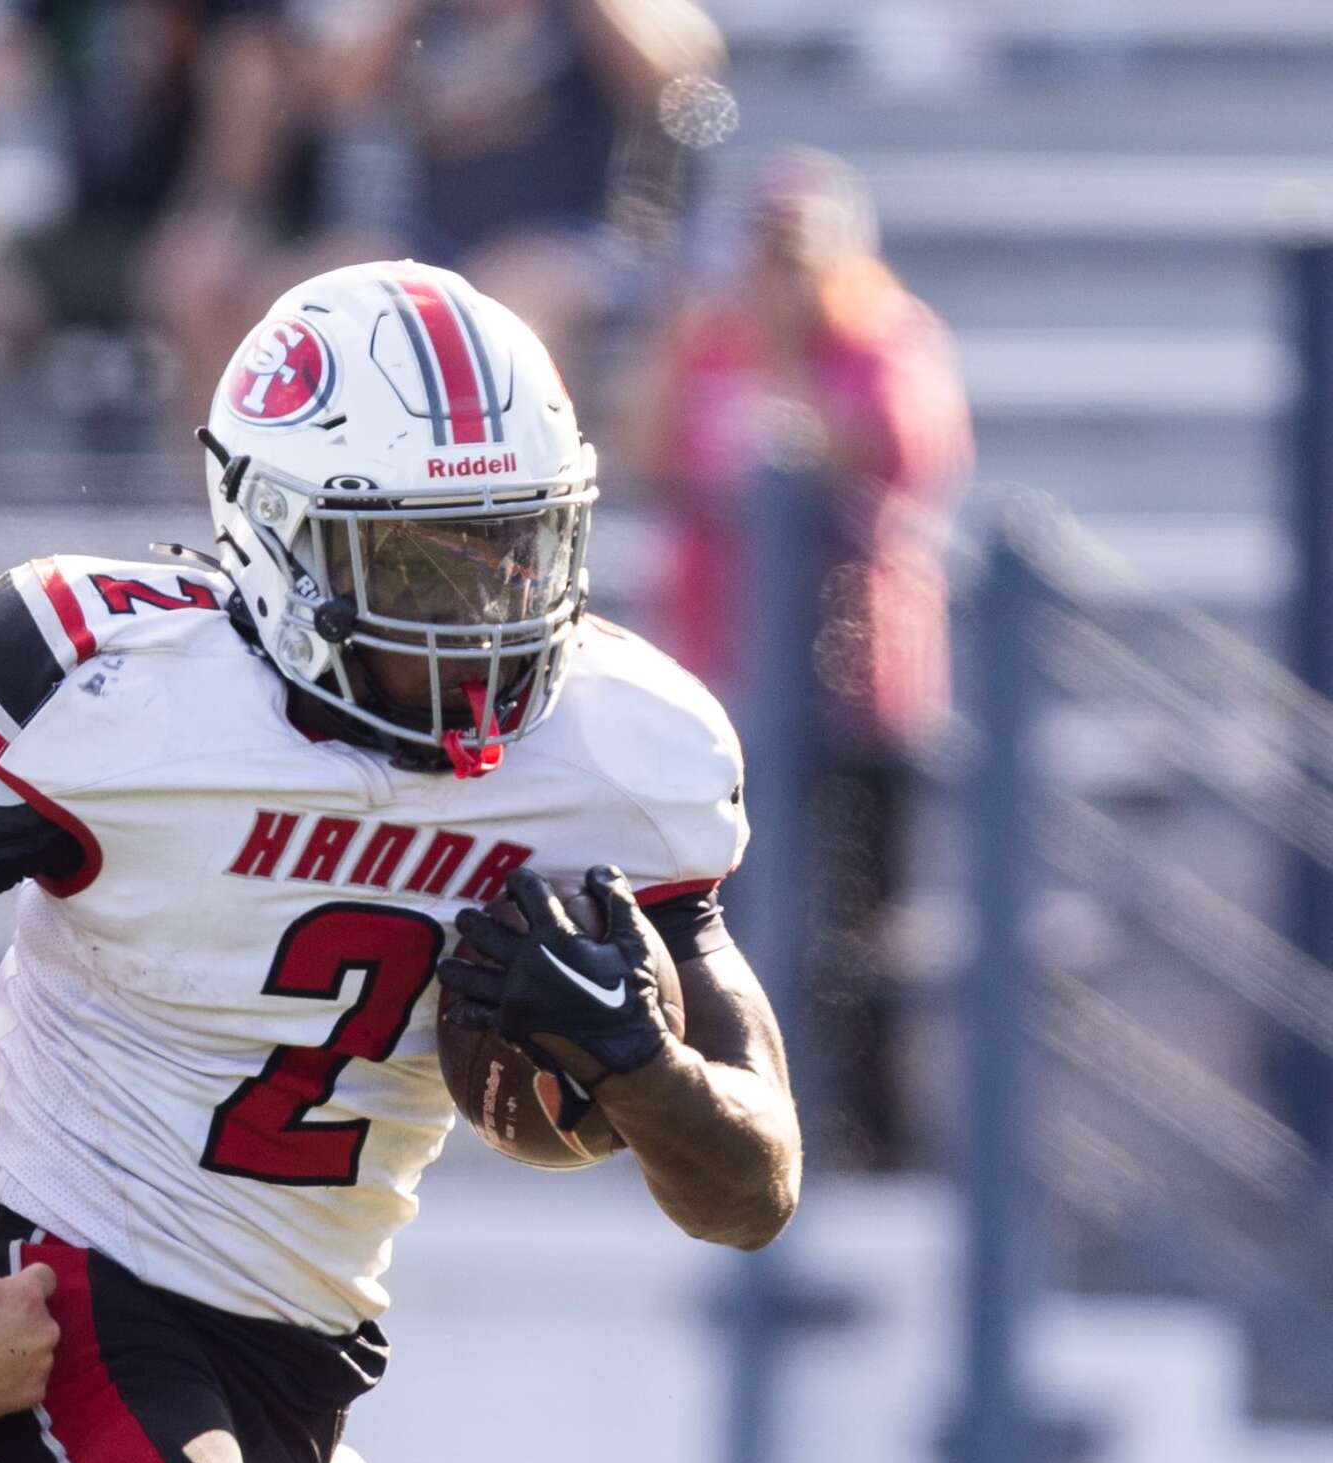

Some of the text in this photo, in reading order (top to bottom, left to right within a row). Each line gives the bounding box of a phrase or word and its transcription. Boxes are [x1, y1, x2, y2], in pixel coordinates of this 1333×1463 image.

[427, 452, 517, 478] Riddell
[222, 808, 533, 902] HANNA
[199, 901, 446, 1187] 2
